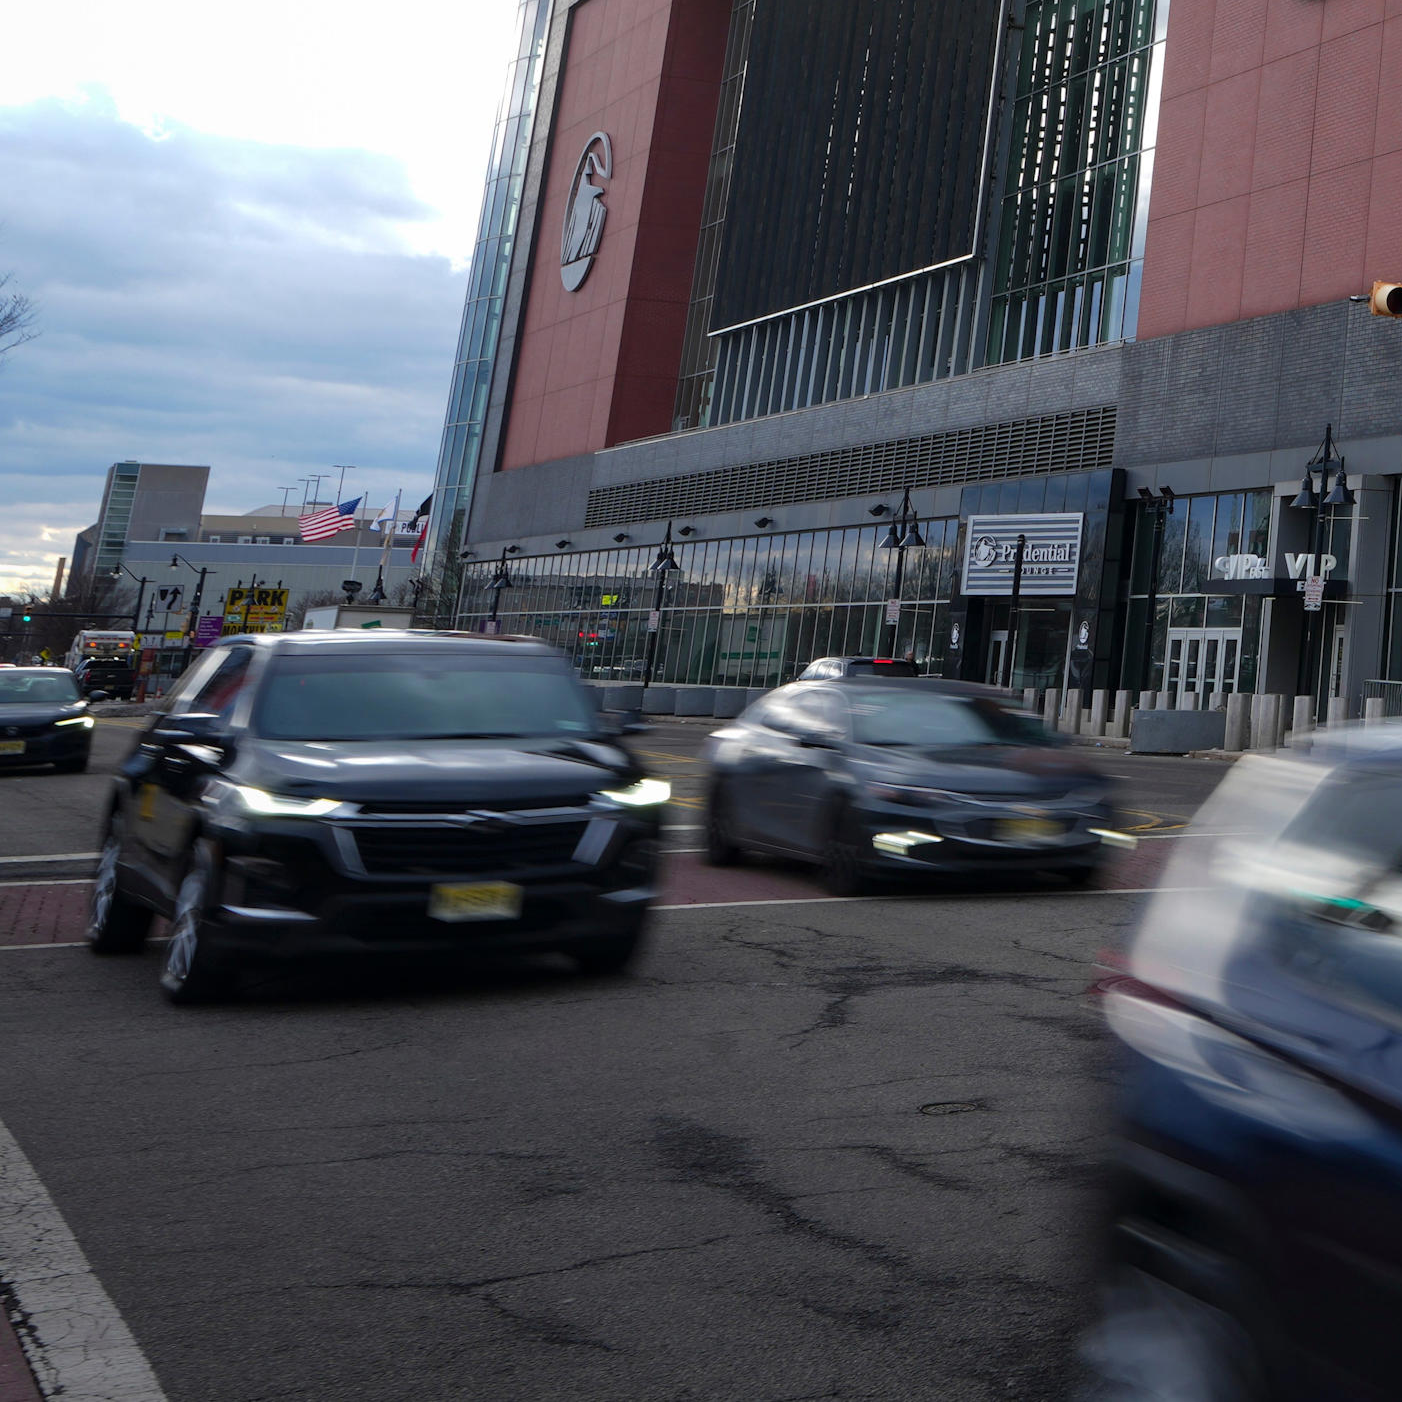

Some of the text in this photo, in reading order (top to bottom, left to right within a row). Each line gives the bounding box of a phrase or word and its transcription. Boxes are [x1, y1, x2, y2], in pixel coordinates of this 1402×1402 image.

[1001, 542, 1072, 562] Prdential
[1284, 552, 1338, 579] VIP
[228, 589, 286, 606] PRK
